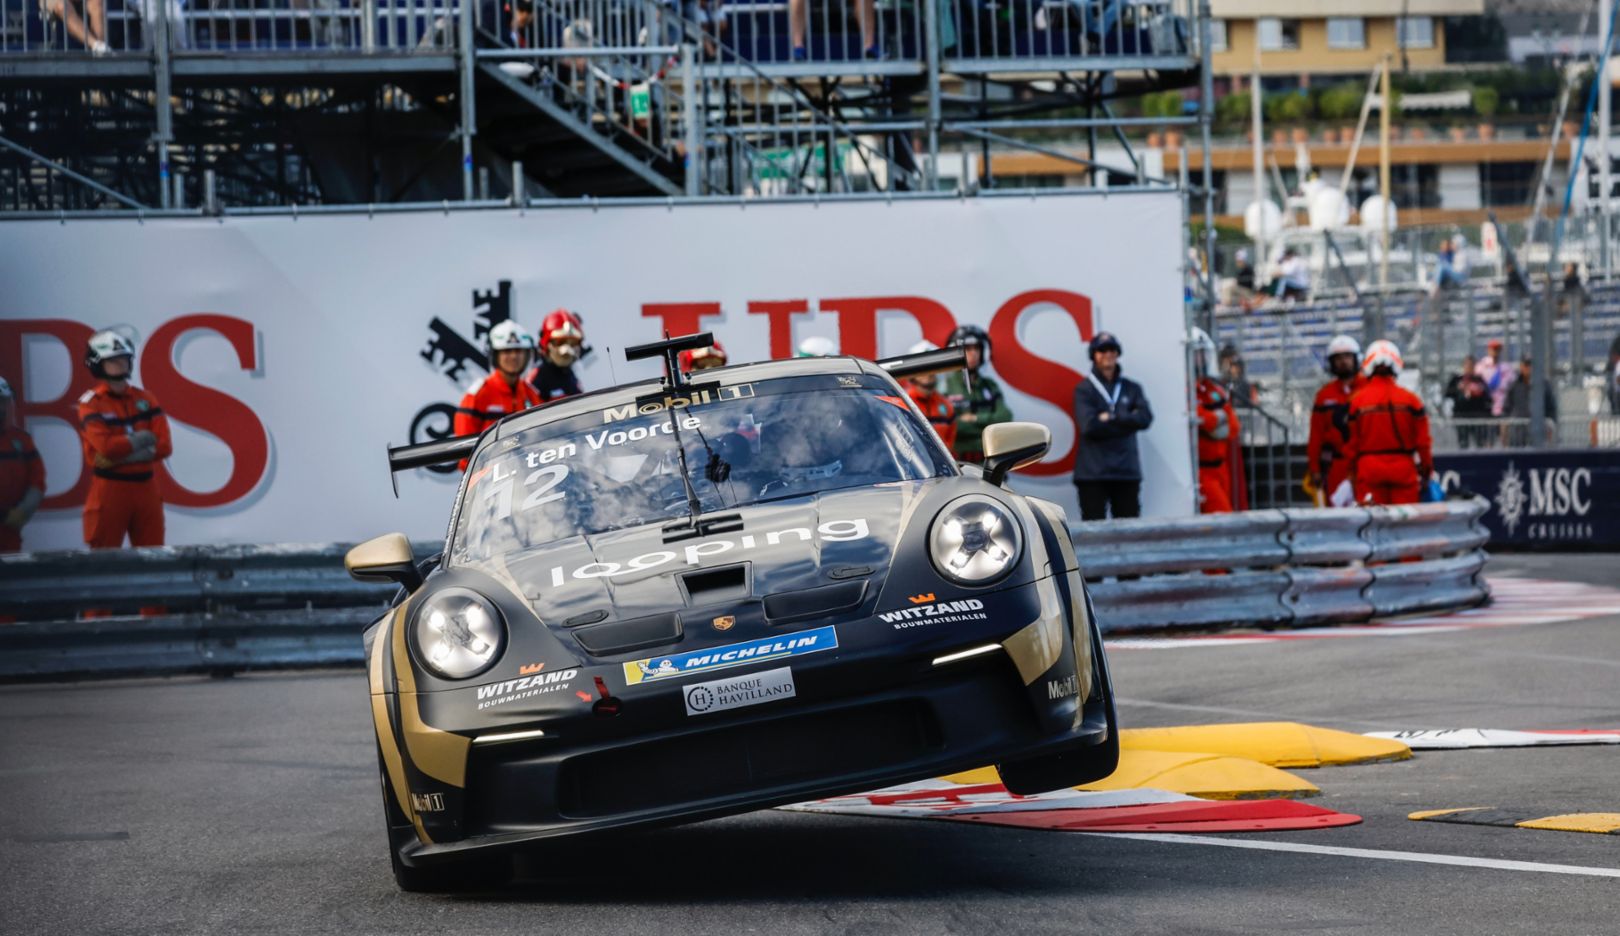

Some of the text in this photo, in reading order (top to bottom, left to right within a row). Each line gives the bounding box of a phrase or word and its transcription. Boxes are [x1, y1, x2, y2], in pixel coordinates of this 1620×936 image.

[603, 390, 711, 424] Mobil
[493, 416, 702, 484] L. ten Voorde
[484, 464, 570, 521] 12
[1528, 467, 1592, 516] MSC
[549, 517, 870, 588] looping
[878, 598, 985, 624] WITZAND
[893, 612, 988, 630] BOUWMATERIALEN
[684, 635, 818, 668] MICHELIN
[476, 668, 578, 700] WITZAND
[477, 683, 570, 710] BOUWMATERIALEN
[716, 678, 762, 695] BANQUE
[718, 683, 793, 706] HAVILLAND
